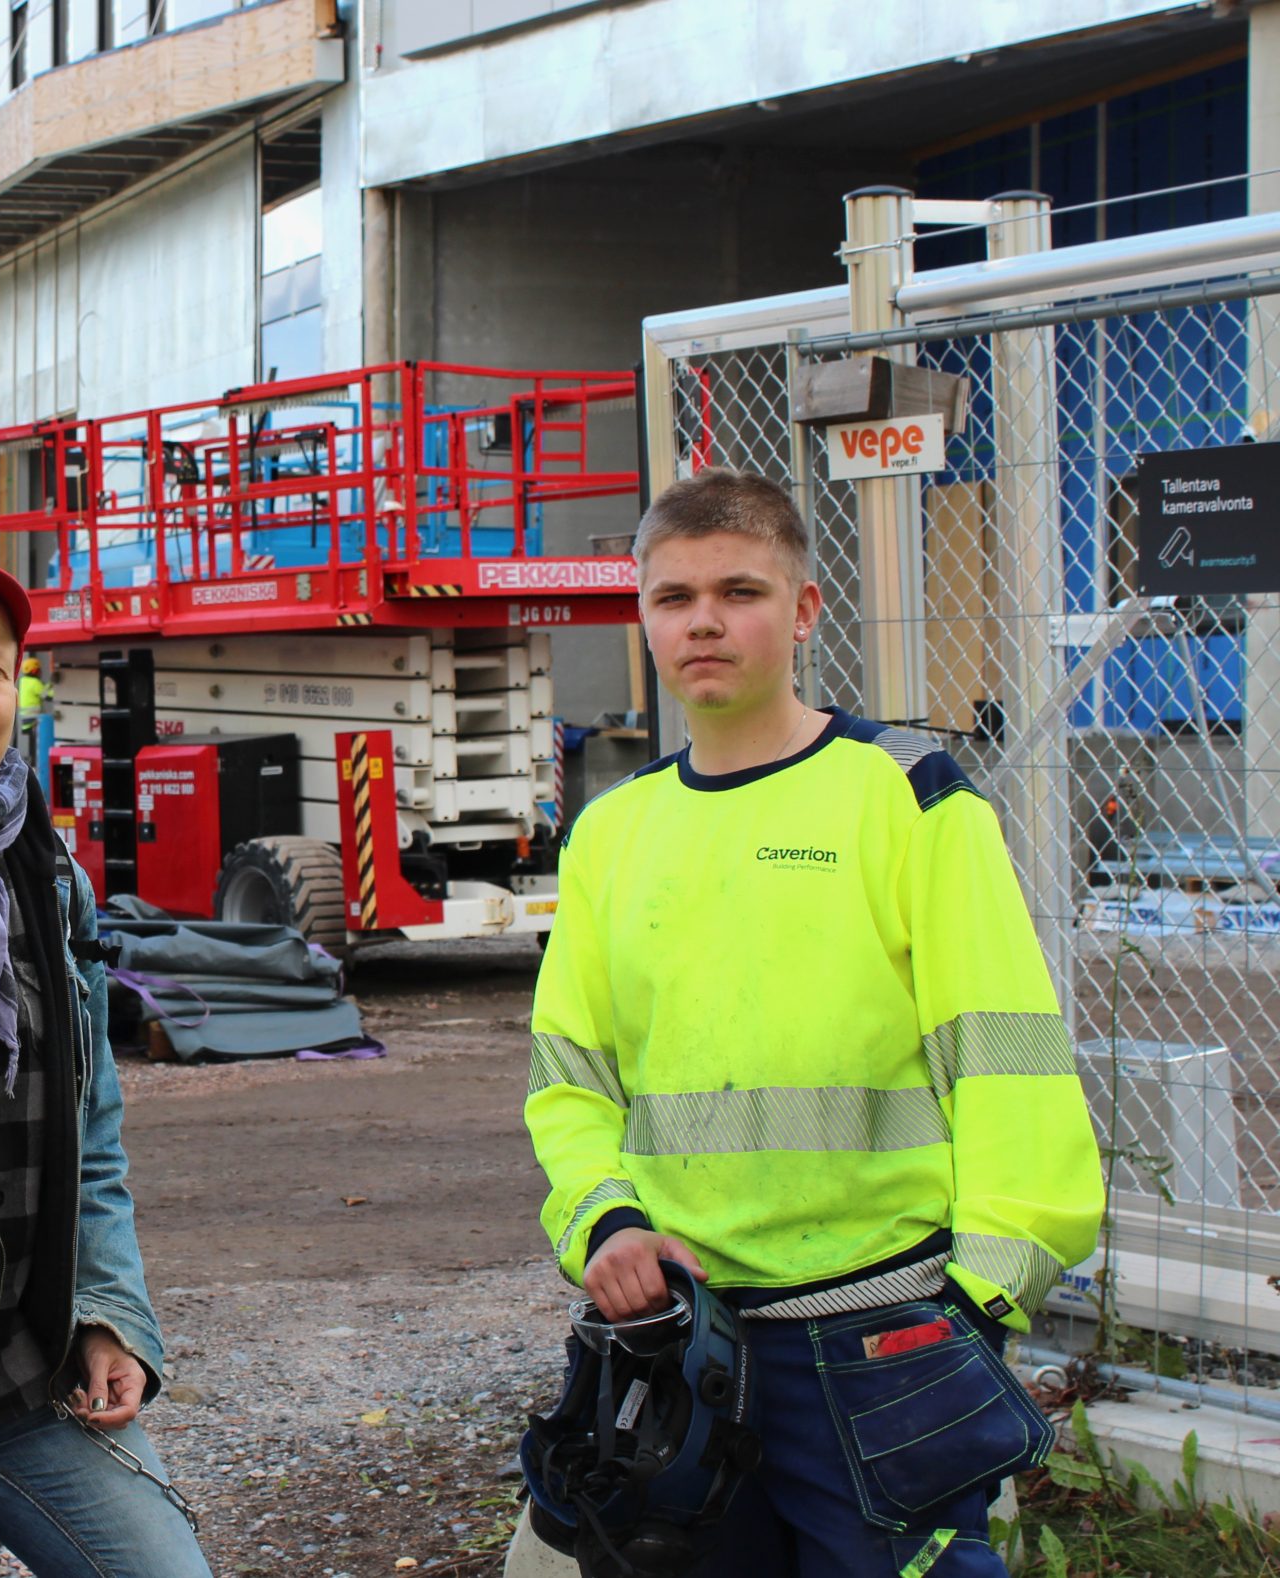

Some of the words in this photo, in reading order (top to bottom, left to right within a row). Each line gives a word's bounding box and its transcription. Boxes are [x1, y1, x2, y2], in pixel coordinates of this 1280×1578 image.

[840, 424, 925, 468] vepe
[891, 456, 918, 468] vepe.fi
[1161, 478, 1221, 494] Tallentava
[1162, 496, 1254, 515] kameravalvonta
[479, 562, 638, 588] PEKKANISK
[192, 581, 277, 605] PEKKANISKA
[522, 606, 540, 622] JG
[544, 606, 571, 621] 076
[756, 846, 837, 863] Caverion
